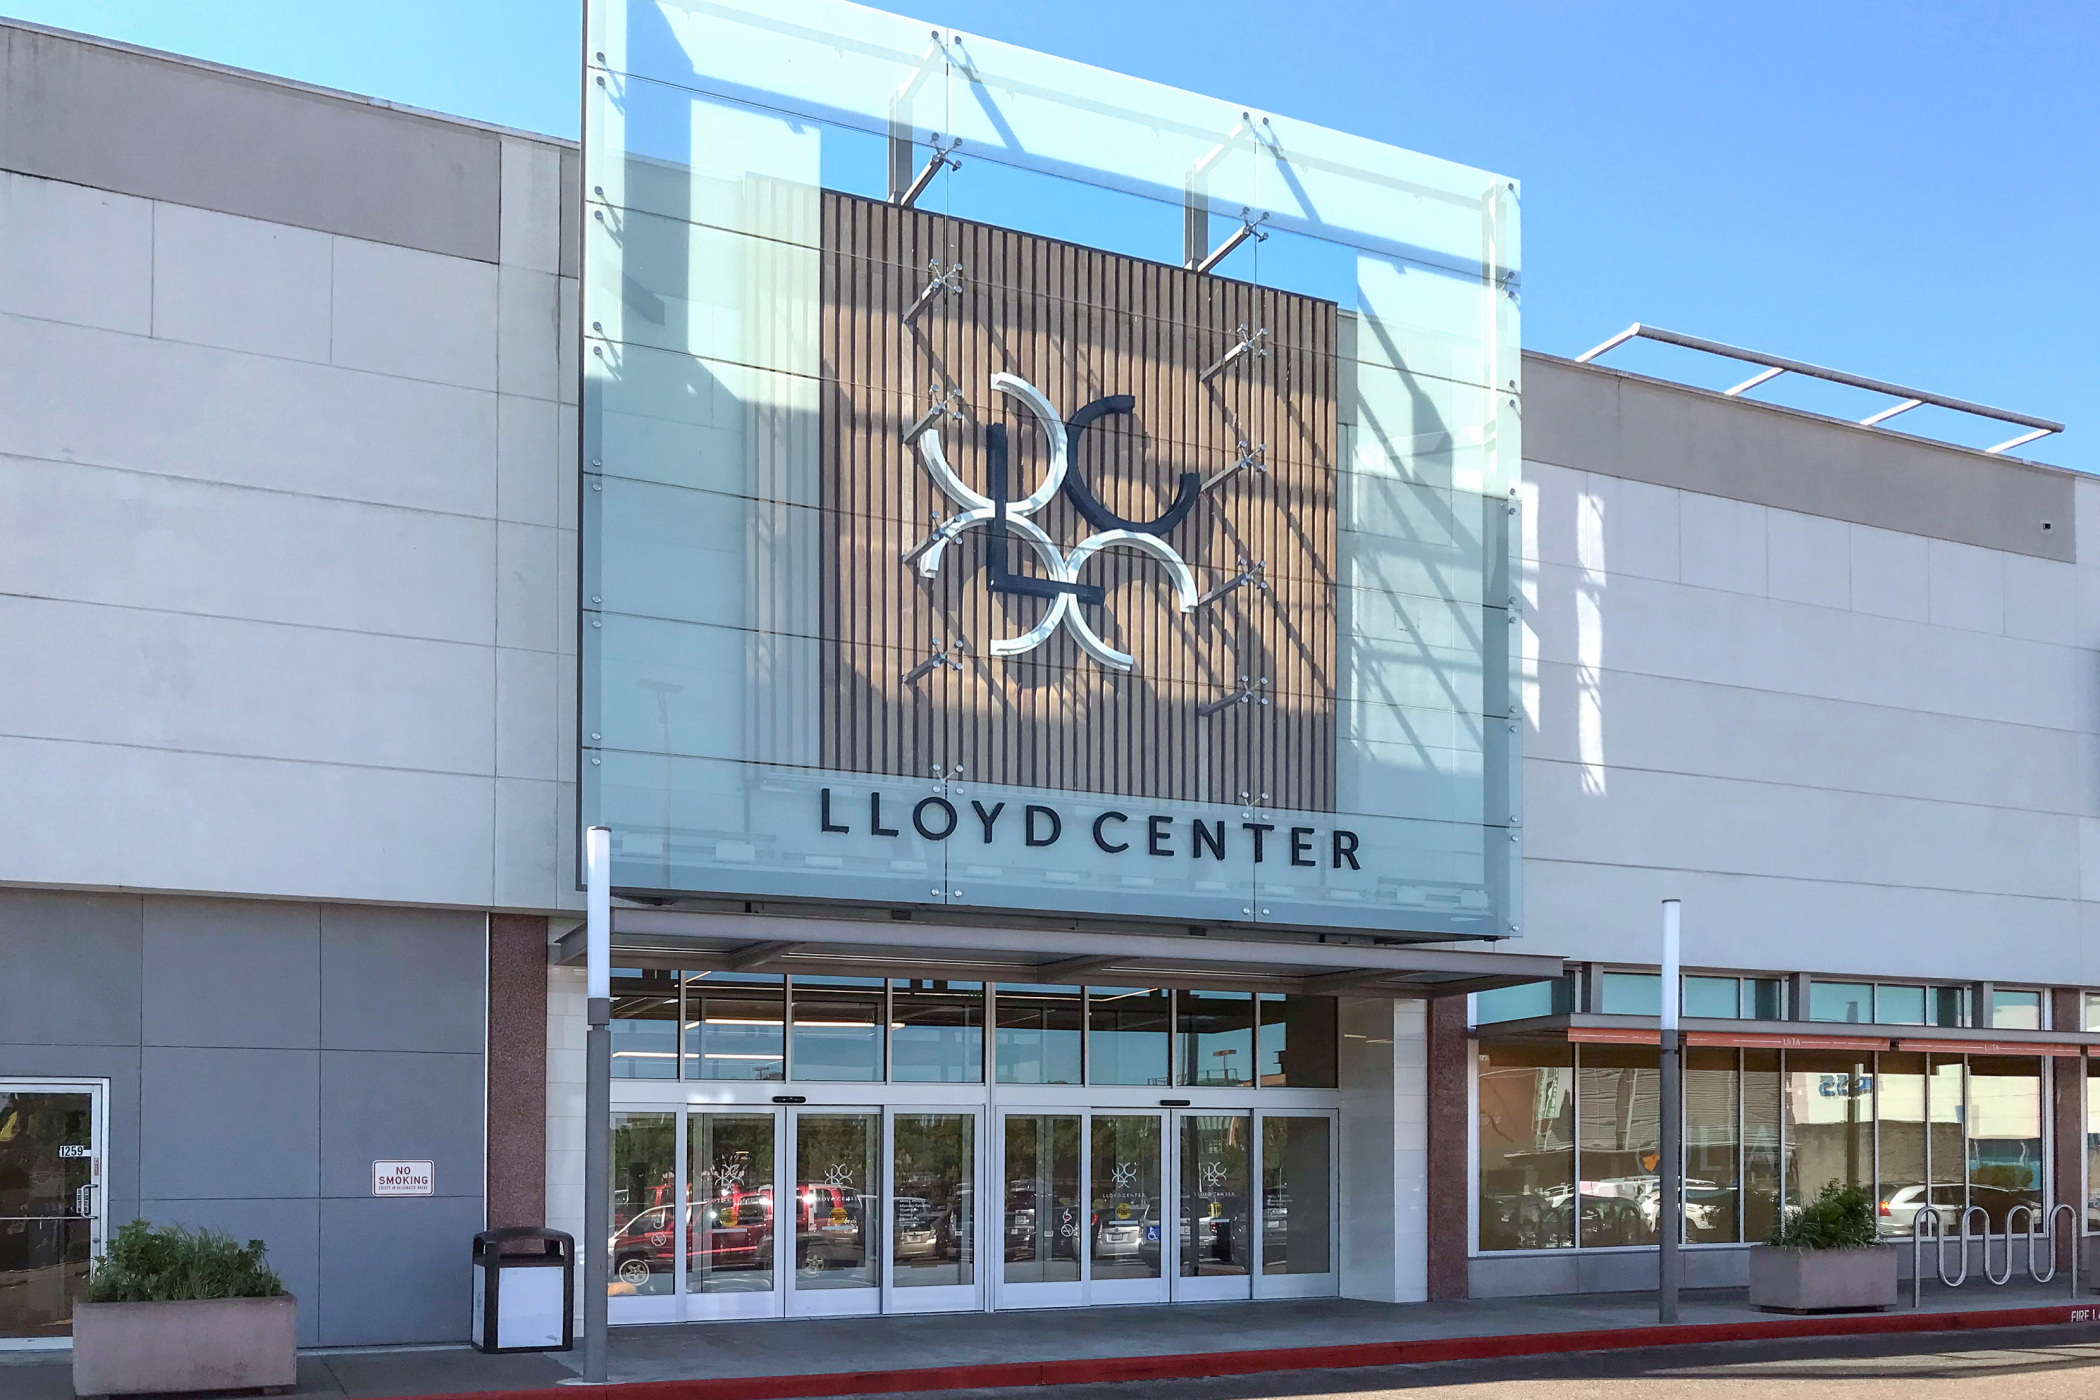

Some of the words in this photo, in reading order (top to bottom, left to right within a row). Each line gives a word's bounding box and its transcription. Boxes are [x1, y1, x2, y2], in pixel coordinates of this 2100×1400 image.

[821, 788, 1061, 848] LLOYD
[1092, 811, 1361, 871] CENTER
[60, 1146, 84, 1157] 1259
[396, 1166, 411, 1175] NO
[378, 1176, 428, 1185] SMOKING
